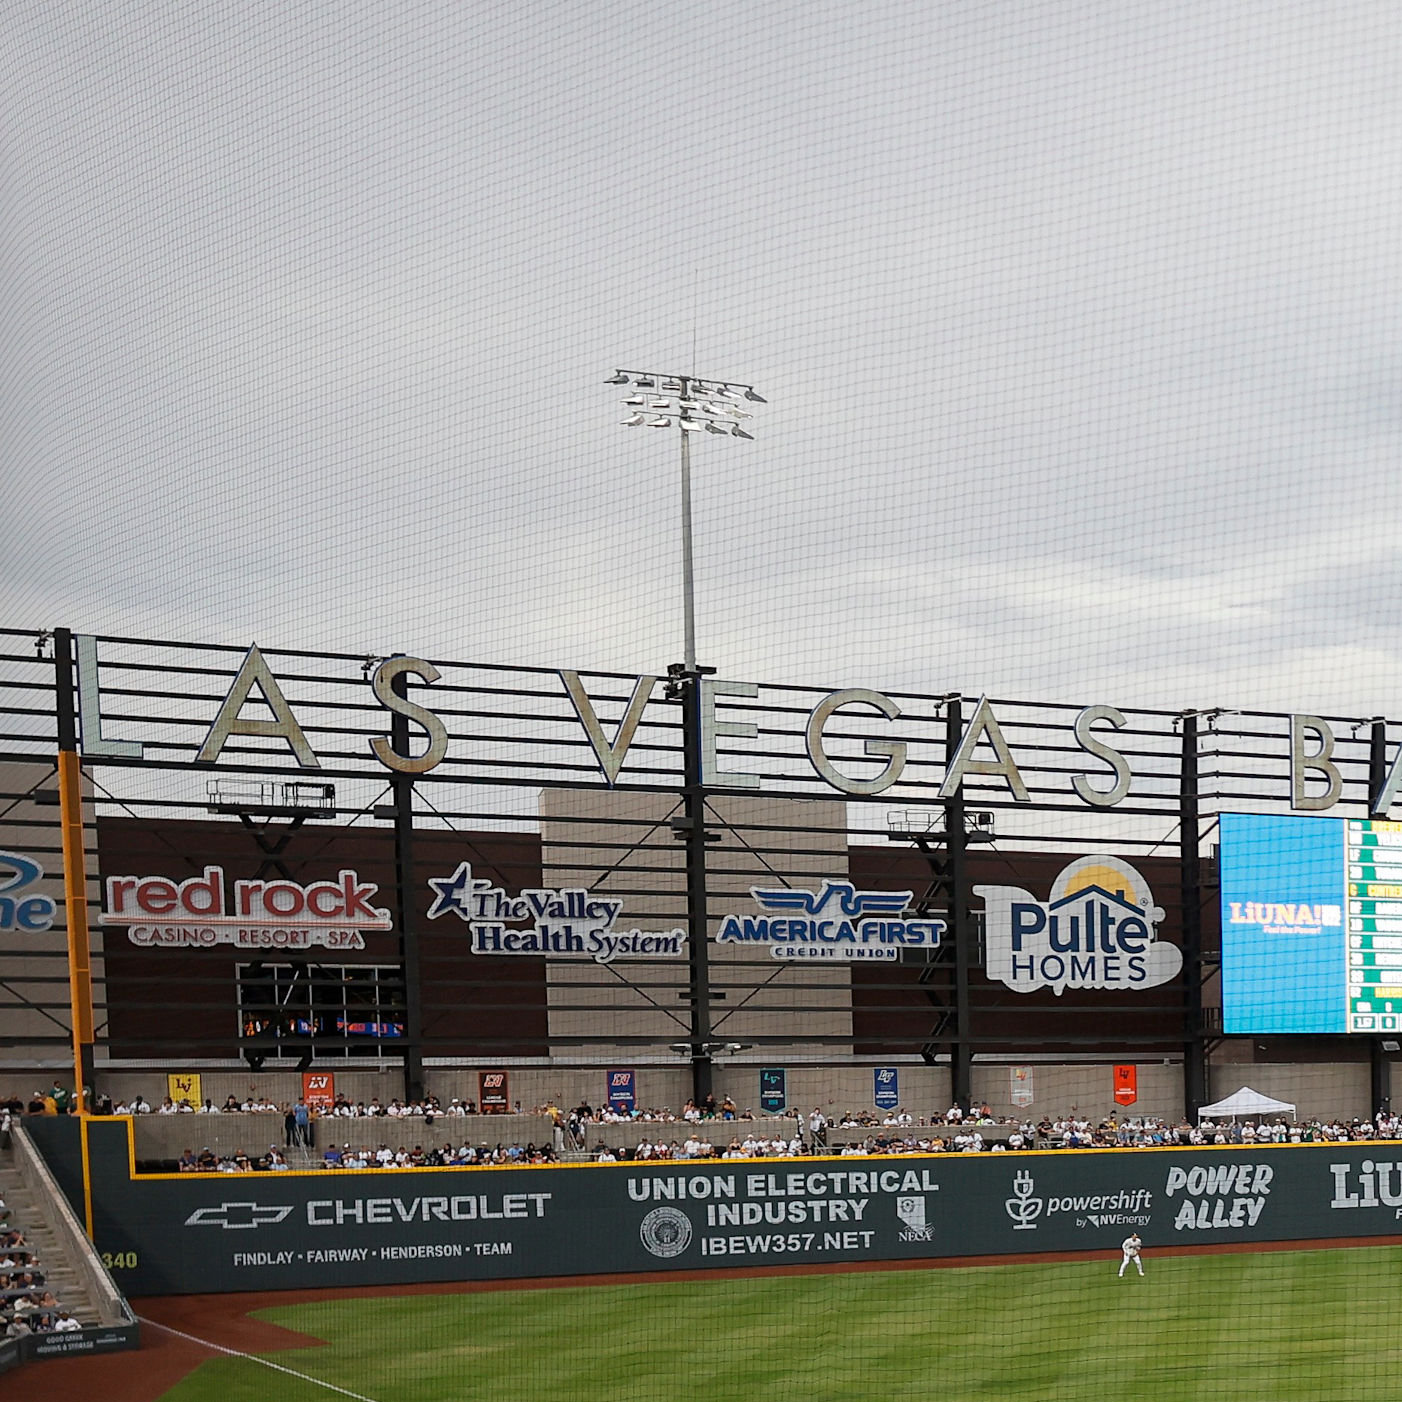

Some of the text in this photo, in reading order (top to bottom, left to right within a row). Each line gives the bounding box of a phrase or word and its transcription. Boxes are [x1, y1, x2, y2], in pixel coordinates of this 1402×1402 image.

[75, 633, 449, 774] LAS
[558, 669, 1132, 807] VEGAS
[112, 871, 378, 918] red rock
[472, 891, 621, 927] The Valley
[1229, 902, 1322, 925] LiUNA!
[134, 927, 363, 946] CASINO RESORT SPA
[721, 918, 945, 944] AMERICA FIRST
[1011, 898, 1149, 954] Pulte
[475, 925, 679, 959] Health System
[775, 947, 896, 958] CREDIT UNION
[1012, 955, 1148, 982] HOMES
[627, 1170, 939, 1201] UNION ELECTRICAL
[1165, 1164, 1274, 1197] POWER
[306, 1193, 552, 1226] CHEVROLET
[707, 1199, 869, 1227] INDUSTRY
[1046, 1188, 1153, 1217] powershift
[1174, 1196, 1266, 1231] ALLEY
[898, 1230, 934, 1243] NECA
[1076, 1217, 1087, 1228] by
[233, 1242, 513, 1267] FINDLAY FAIRWAY HENDERSON TEAM
[701, 1230, 875, 1256] IBEW357.NET
[101, 1252, 138, 1269] 340
